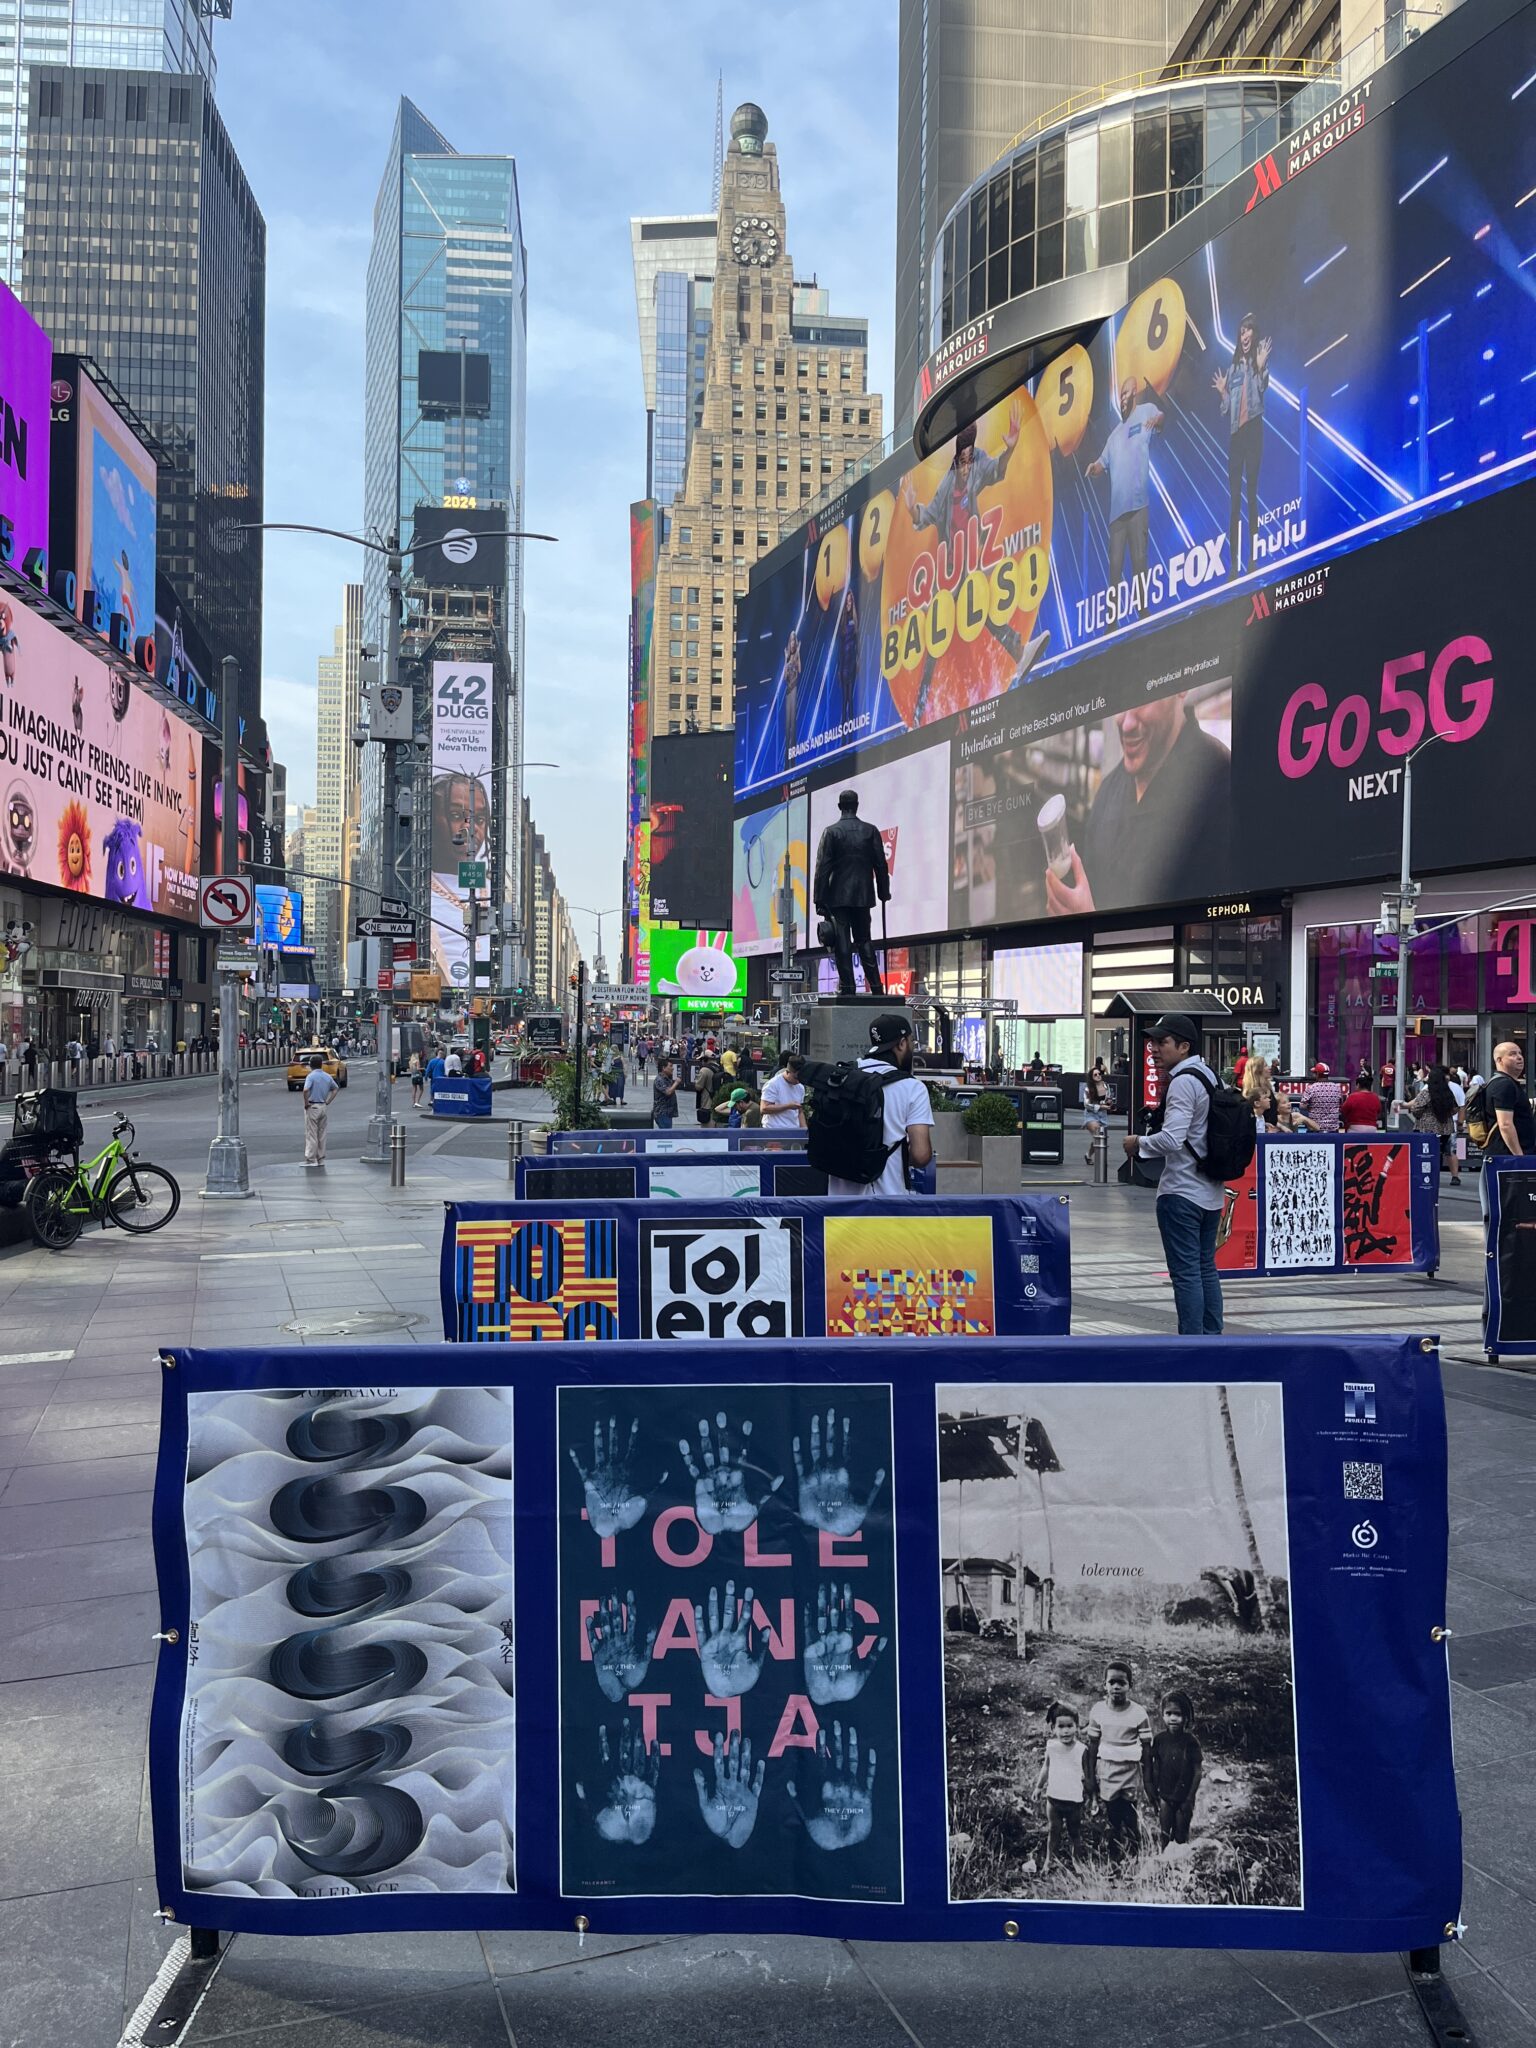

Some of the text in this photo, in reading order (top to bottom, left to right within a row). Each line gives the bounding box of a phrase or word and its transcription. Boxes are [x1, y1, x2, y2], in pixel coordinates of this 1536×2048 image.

[1290, 80, 1373, 153] MARRIOTT
[1289, 108, 1364, 175] MARQUIS
[935, 315, 995, 366] MARRIOTT
[1147, 298, 1169, 350] 6
[936, 338, 986, 384] MARQUIS
[1059, 365, 1075, 416] 5
[50, 408, 70, 422] LG
[0, 393, 28, 481] N
[443, 496, 477, 510] 2024
[820, 494, 848, 521] MARRIOTT
[1257, 497, 1302, 526] NEXT DAY
[820, 509, 845, 535] MARQUIS
[869, 507, 881, 547] 2
[1004, 522, 1042, 557] WITH
[1253, 519, 1307, 561] hulu
[824, 544, 832, 578] 1
[907, 504, 1005, 610] QUIZ
[1169, 533, 1228, 597] FOX
[1275, 567, 1331, 596] MARRIOTT
[1275, 584, 1324, 611] MARQUIS
[885, 553, 1039, 671] BALLS!
[888, 597, 907, 625] THE
[1076, 563, 1164, 638] TUESDAYS
[84, 590, 248, 745] BROADWY
[1146, 656, 1220, 692] @hydrafacial #hydrafacial
[438, 675, 487, 706] 42
[437, 705, 489, 720] DUGG
[970, 699, 1000, 717] MARRIOTT
[970, 712, 996, 728] MARQUIS
[1009, 727, 1021, 740] Get
[1021, 722, 1033, 737] the
[1033, 717, 1049, 733] Best
[1049, 711, 1065, 729] Skin
[1065, 708, 1074, 723] of
[1075, 702, 1091, 720] Your
[1091, 696, 1107, 712] Life.
[438, 743, 487, 753] Neva Them
[444, 735, 480, 744] 4eva Us
[788, 713, 870, 760] BRAINS AND BALLS COLLIDE
[9, 700, 183, 815] IMAGINARY FRIENDS LIVE IN NYC
[23, 743, 54, 781] JUST
[57, 760, 92, 799] CAN'T
[95, 778, 113, 810] SEE
[115, 788, 145, 826] THEM)
[1349, 768, 1402, 802] NEXT
[968, 793, 1032, 821] BYE BYE GUNK
[263, 830, 271, 865] 1500
[146, 842, 164, 903] IF
[164, 865, 199, 890] NOW PLAYING
[384, 902, 394, 911] ONE
[1207, 903, 1251, 917] SEPHORA
[364, 923, 409, 932] ONE WAY
[75, 990, 104, 1007] FOREVER
[635, 986, 648, 994] ZONE
[687, 1000, 734, 1009] NEW YORK
[1327, 994, 1336, 1029] T-MOBILE
[457, 1219, 618, 1303] TOL
[653, 1234, 760, 1296] Tol
[1345, 1384, 1374, 1392] TOLERANCE
[1080, 1562, 1145, 1578] tolerance
